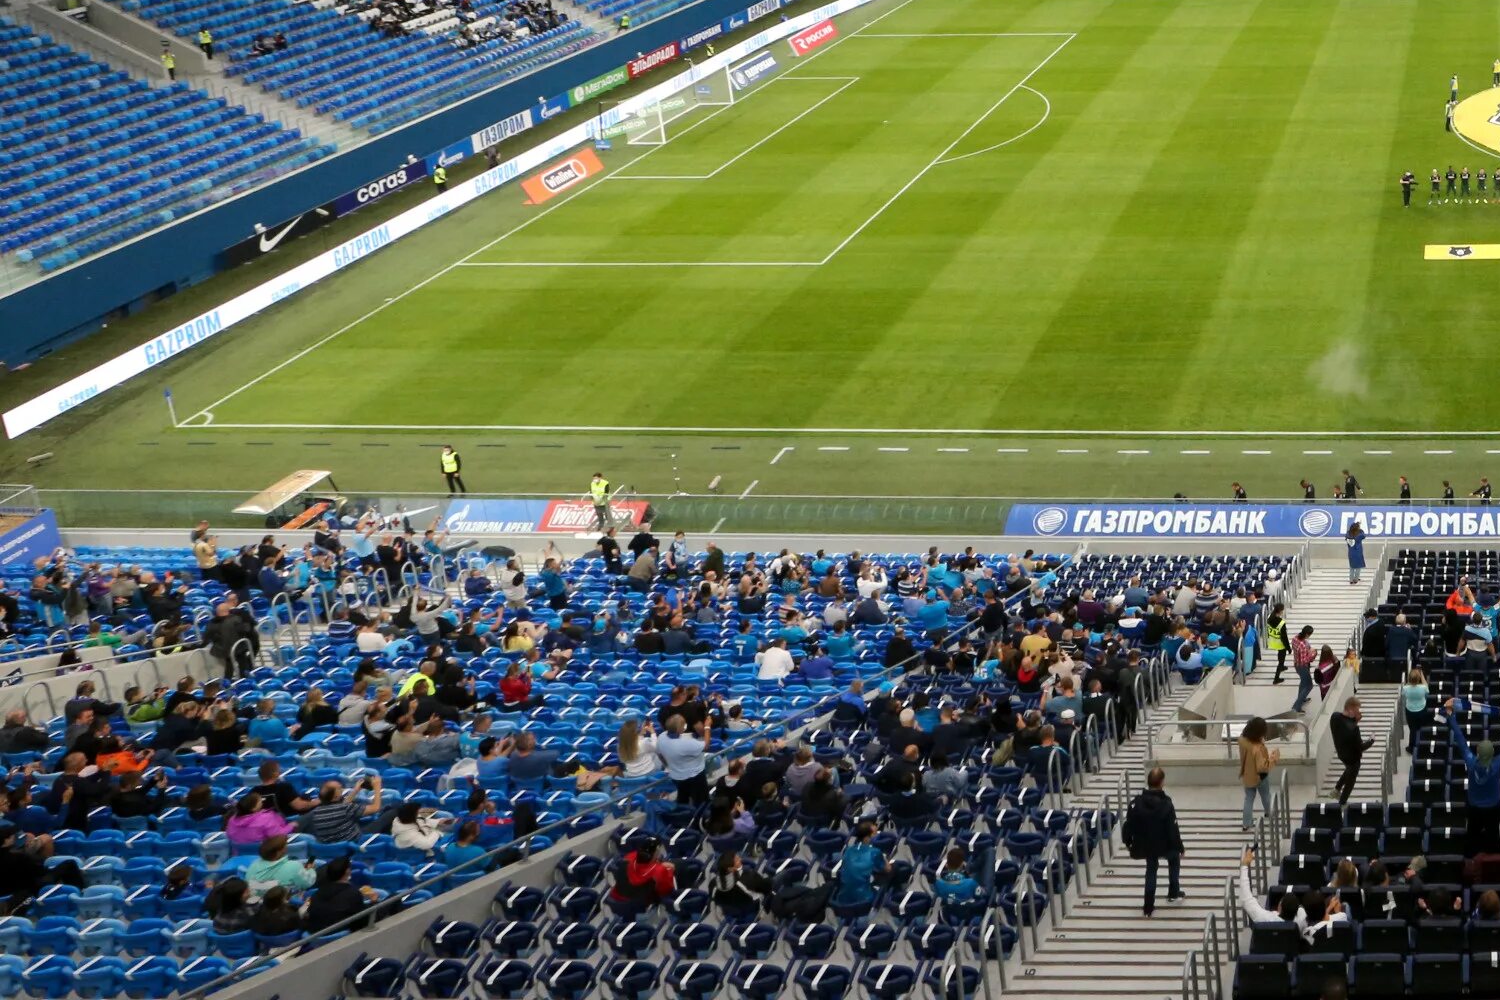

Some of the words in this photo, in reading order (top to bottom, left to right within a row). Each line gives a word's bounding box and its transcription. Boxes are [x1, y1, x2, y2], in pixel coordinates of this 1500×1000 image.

[806, 25, 834, 44] РОССИЯ
[632, 44, 675, 75] ЭЛЬДОРАДО
[480, 114, 526, 148] ГАЗПРОМ
[475, 161, 519, 194] GAZPROM
[334, 226, 391, 268] GAZPROM
[144, 311, 223, 366] GAZPROM
[1072, 510, 1267, 535] ГАЗПРОМБАНК
